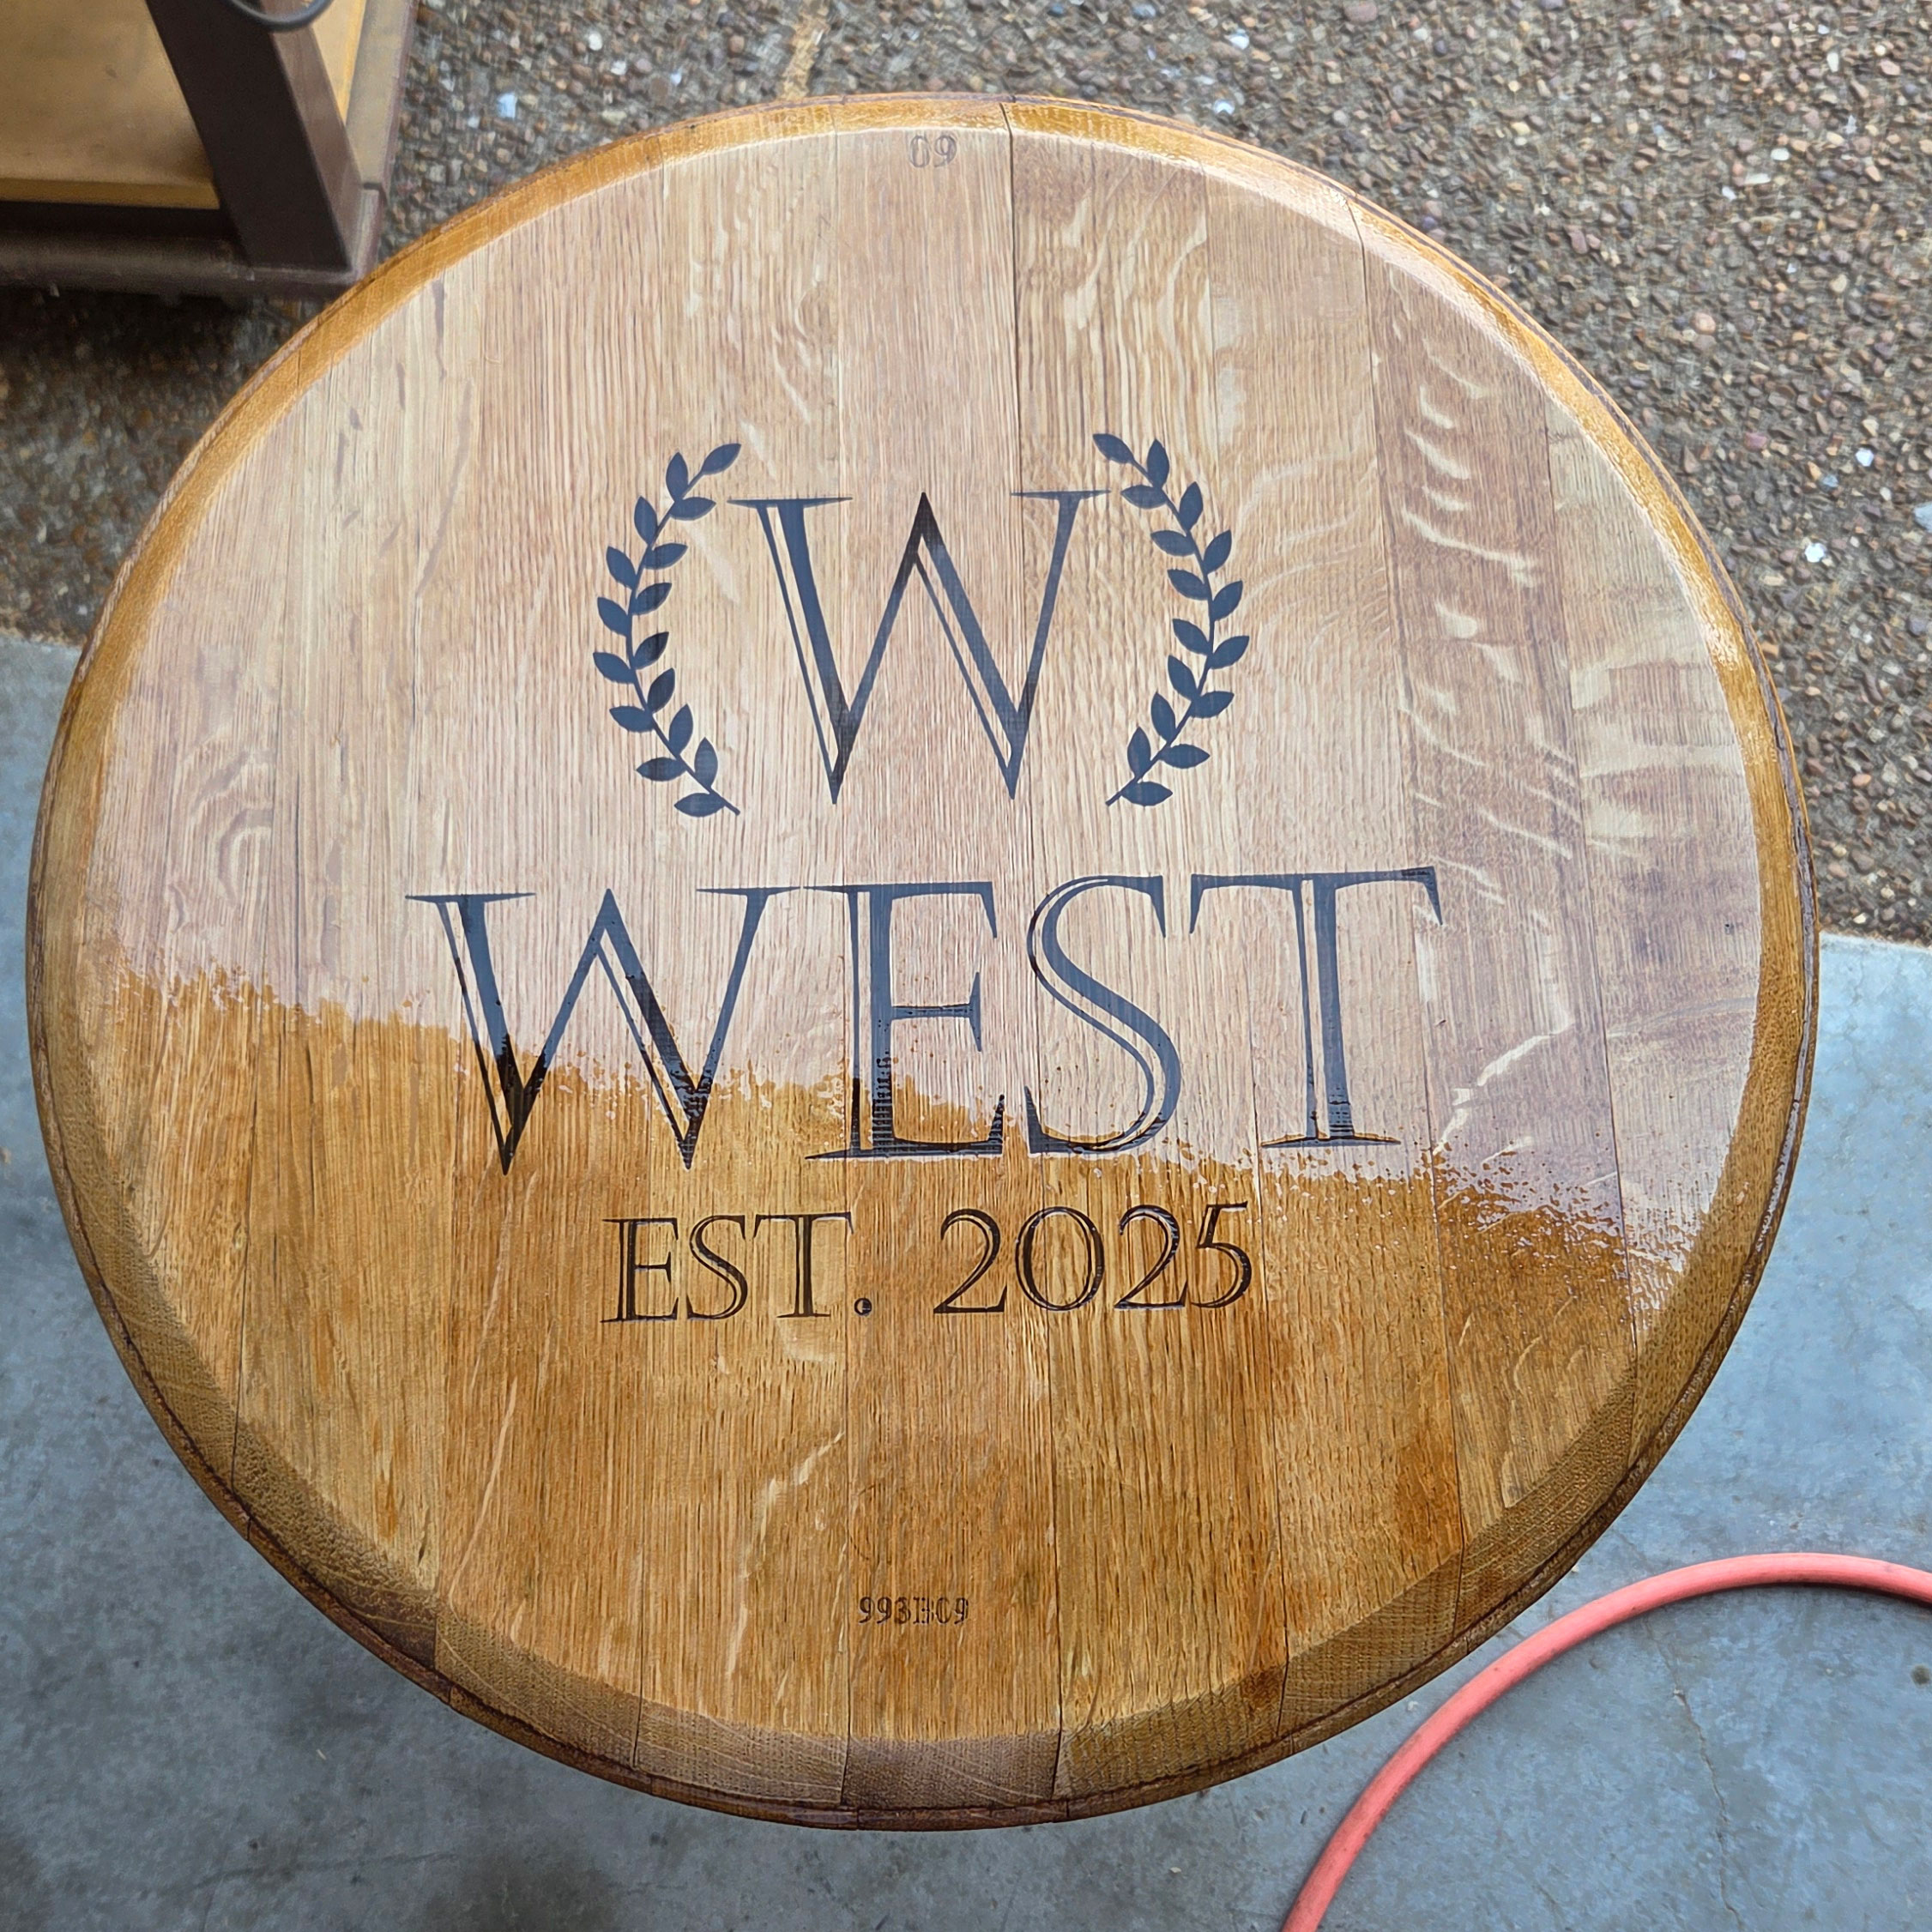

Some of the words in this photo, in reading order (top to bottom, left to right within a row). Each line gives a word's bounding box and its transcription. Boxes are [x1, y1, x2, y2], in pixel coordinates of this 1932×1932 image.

[727, 490, 1111, 805] W
[406, 866, 1443, 1175] WEST
[601, 1212, 872, 1323] EST.
[933, 1201, 1253, 1314] 2025
